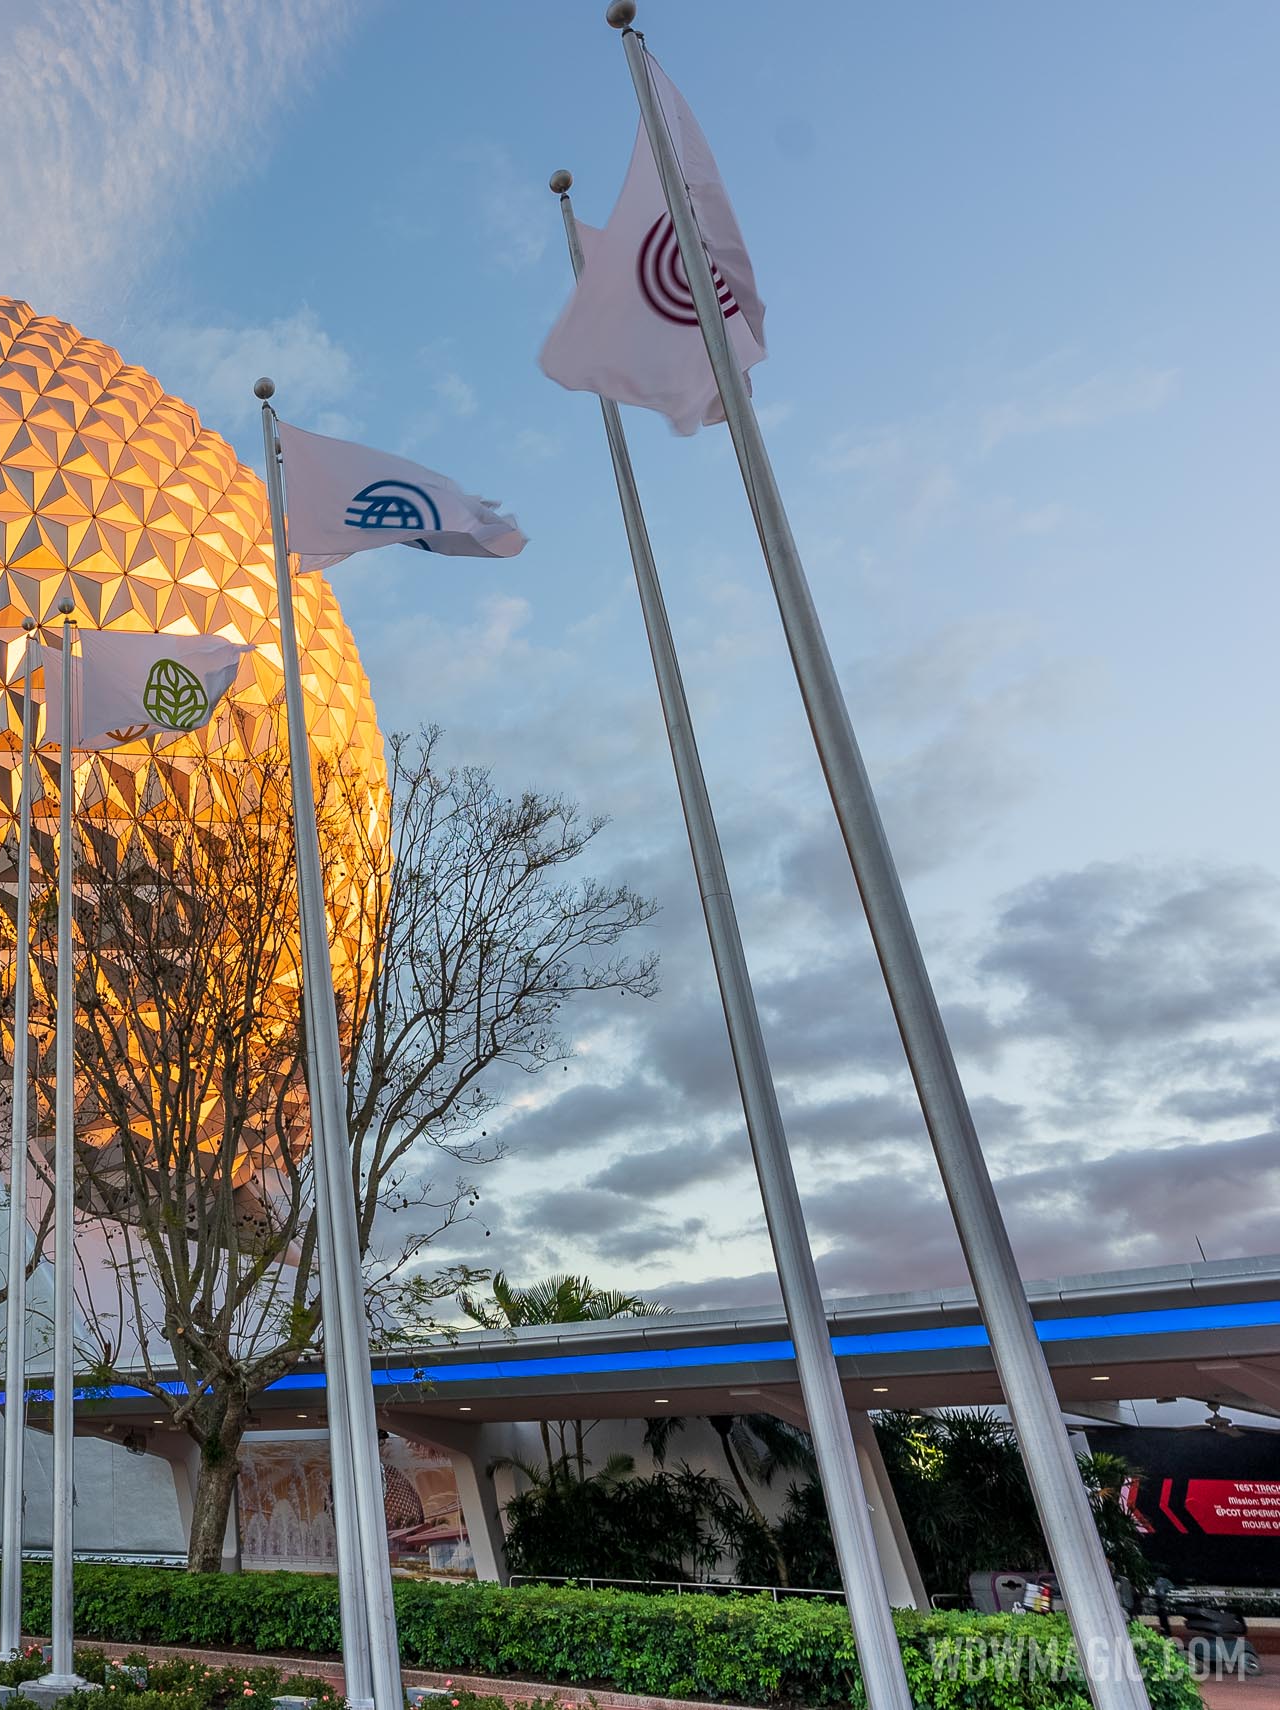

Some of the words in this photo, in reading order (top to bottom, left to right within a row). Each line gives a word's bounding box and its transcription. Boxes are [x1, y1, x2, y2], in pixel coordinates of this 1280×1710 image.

[1233, 1484, 1254, 1492] TEST
[1215, 1508, 1241, 1517] EPCOT
[1241, 1521, 1272, 1529] MOUSE
